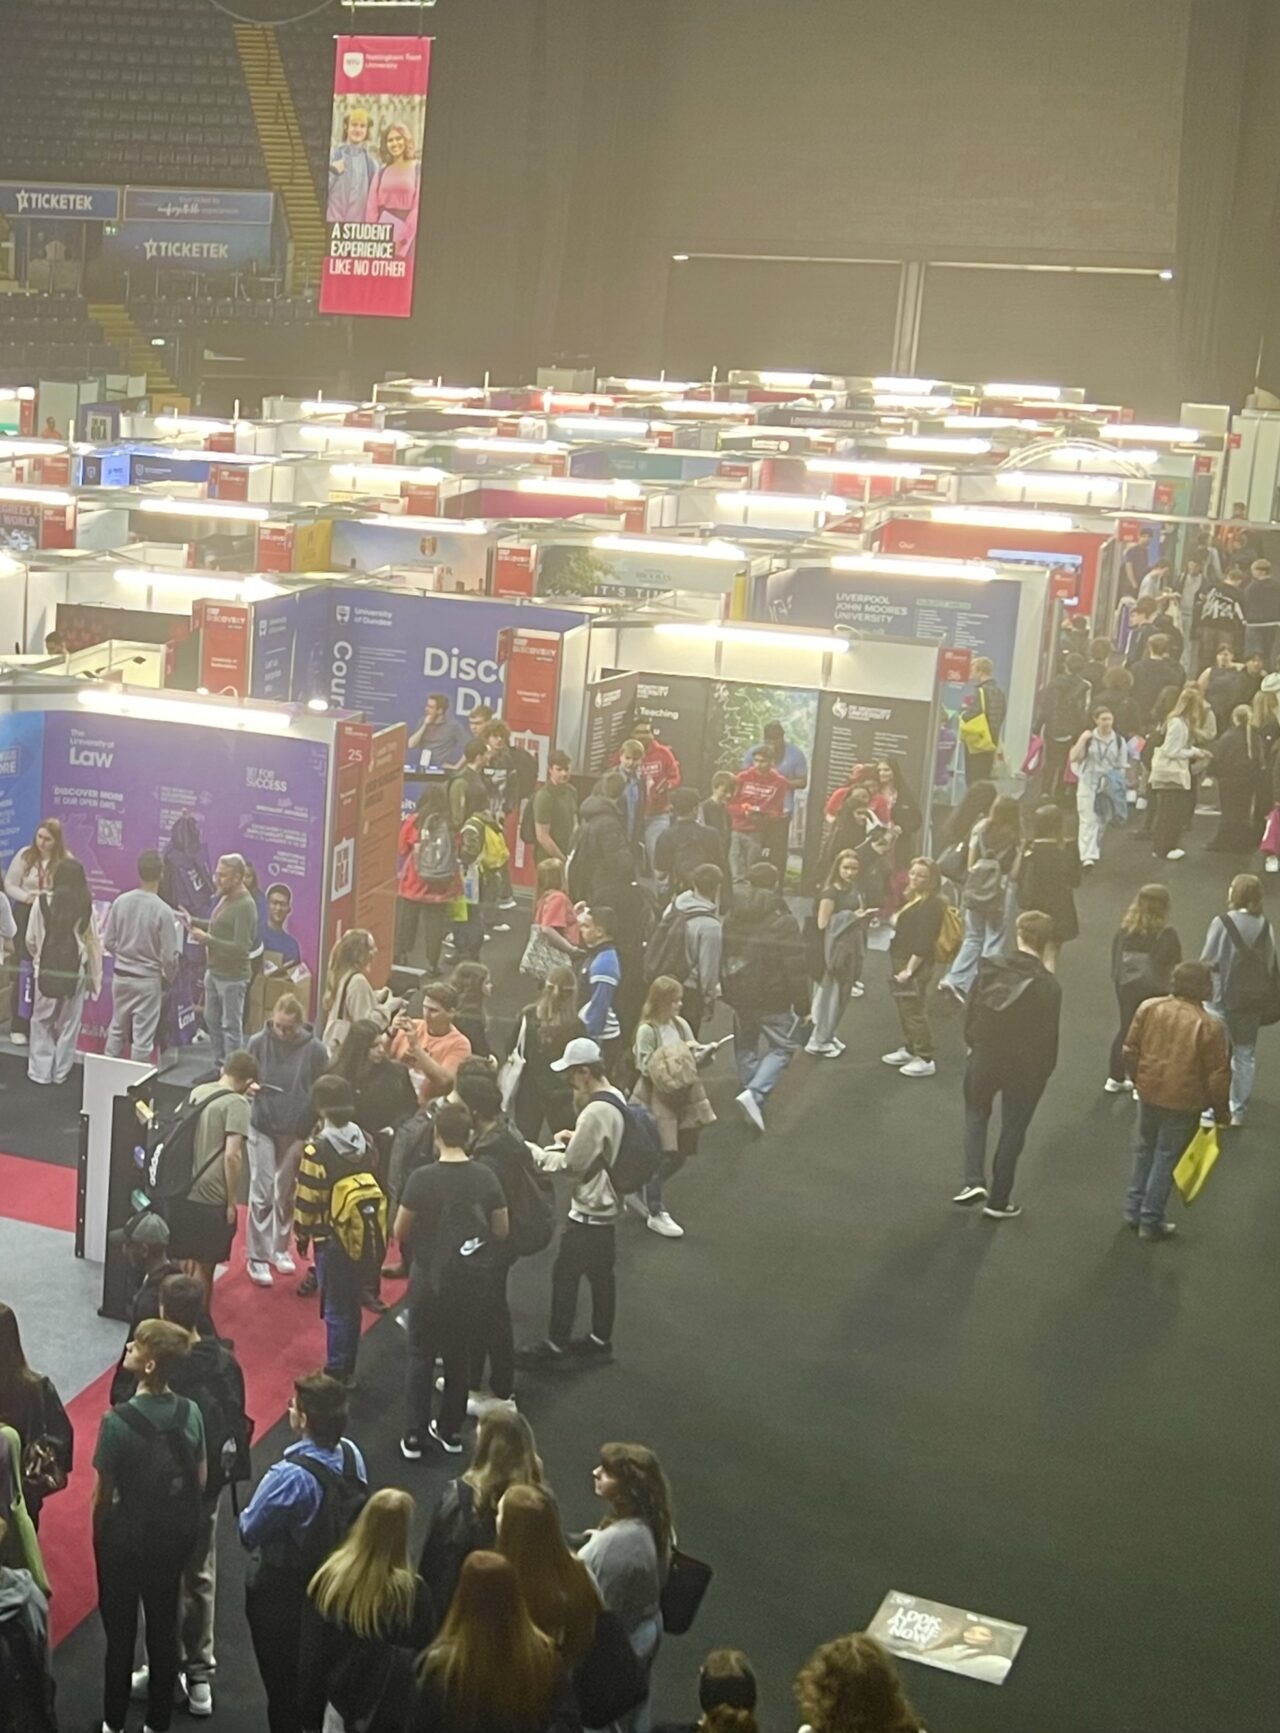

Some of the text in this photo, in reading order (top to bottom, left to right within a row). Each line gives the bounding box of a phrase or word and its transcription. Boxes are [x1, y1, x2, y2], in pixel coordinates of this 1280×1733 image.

[29, 192, 93, 211] TICKETEK
[331, 222, 393, 241] A STUDENT
[159, 241, 229, 259] TICKETEK
[331, 240, 394, 259] EXPERIENCE
[329, 258, 406, 278] LIKE NO OTHER
[594, 585, 627, 598] IT'S
[835, 593, 891, 605] LIVERPOOL
[354, 606, 392, 619] University
[835, 603, 908, 616] JOHN MOORES
[362, 617, 393, 628] Dundee
[834, 612, 894, 624] UNIVERSITY
[639, 706, 680, 721] Teaching
[71, 728, 85, 737] The
[70, 738, 107, 749] University
[70, 746, 114, 769] Law
[347, 749, 363, 762] 25
[258, 768, 275, 779] FOR
[246, 777, 288, 793] SUCCESS
[53, 786, 124, 802] DISCOVER MORE
[62, 797, 78, 806] OUR
[79, 798, 98, 808] OPEN
[896, 1606, 943, 1630] LOOK
[888, 1626, 933, 1644] NOW
